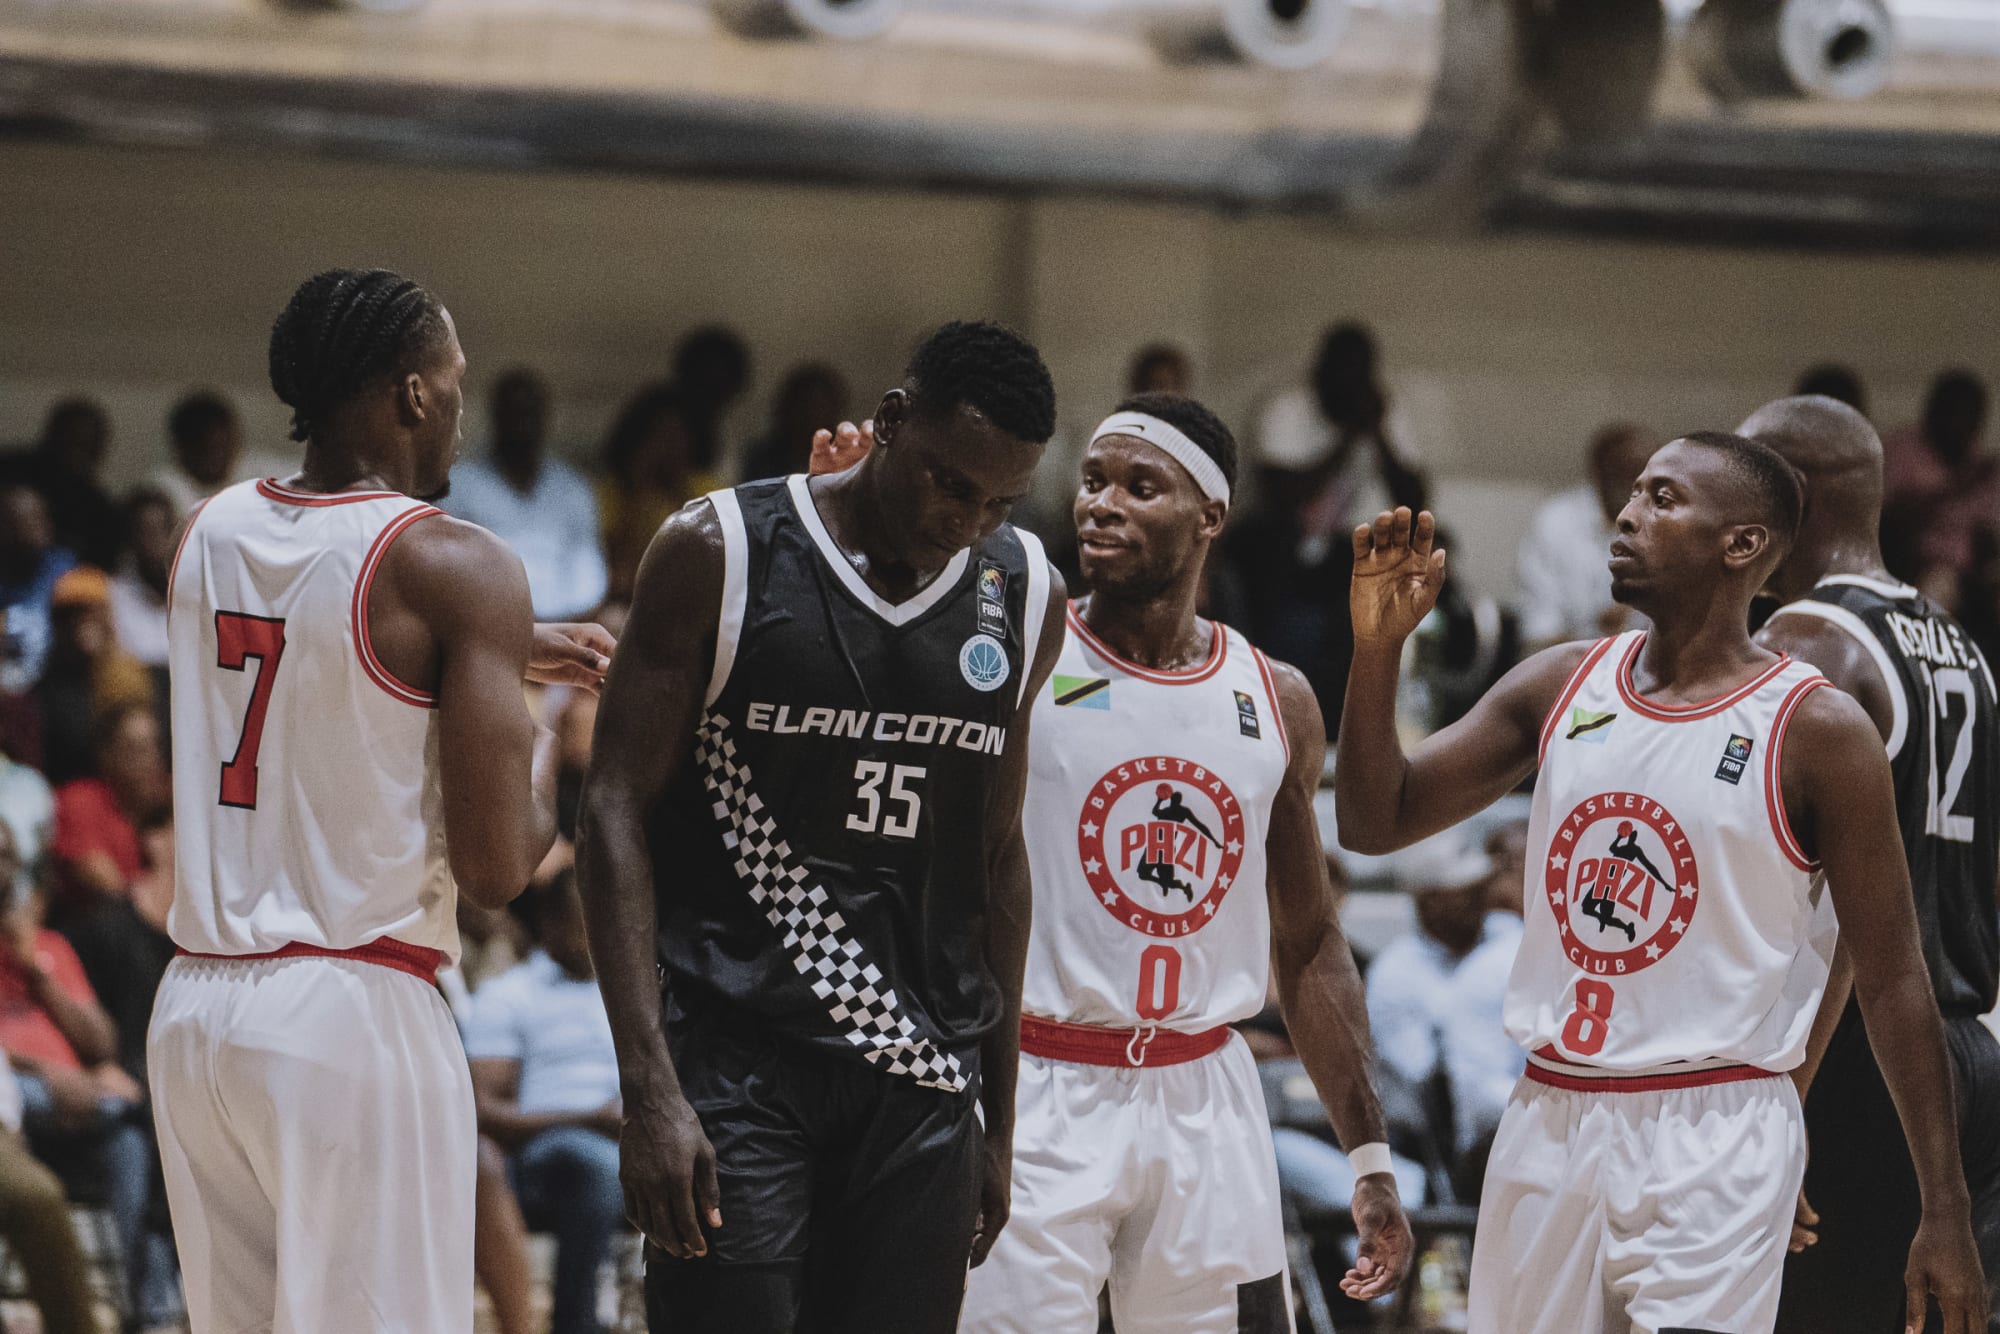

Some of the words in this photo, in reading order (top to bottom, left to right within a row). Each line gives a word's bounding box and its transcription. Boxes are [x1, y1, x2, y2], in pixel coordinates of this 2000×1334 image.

[215, 610, 286, 810] 7
[746, 702, 871, 739] ELAN
[872, 712, 1006, 756] COTON
[1919, 659, 1976, 843] 12
[846, 759, 927, 839] 35
[1091, 758, 1240, 826] BASKETBALL
[1120, 821, 1208, 880] PAZI
[1561, 794, 1694, 868] BASKETBALL
[1129, 913, 1191, 936] CLUB
[1572, 857, 1656, 922] PAZI
[1135, 943, 1182, 1022] 0
[1569, 946, 1627, 974] CLUB
[1560, 977, 1615, 1057] 8
